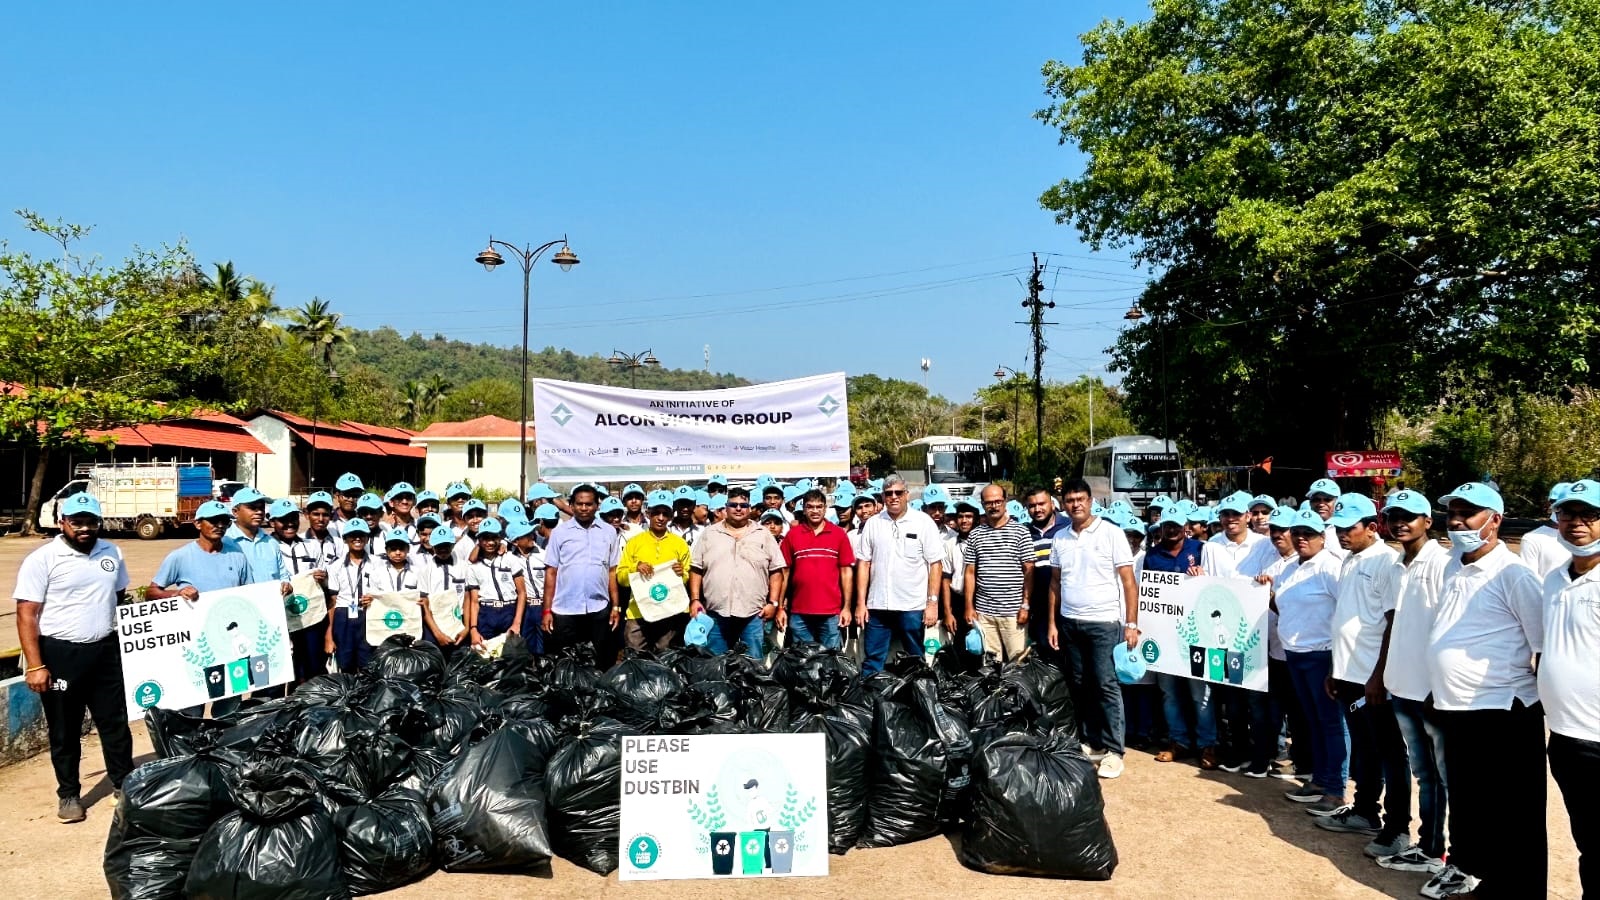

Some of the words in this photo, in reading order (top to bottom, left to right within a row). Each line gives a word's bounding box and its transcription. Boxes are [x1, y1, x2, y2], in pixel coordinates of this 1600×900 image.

[649, 400, 664, 408] AN
[666, 400, 719, 408] INITIATIVE
[721, 399, 735, 408] OF
[595, 413, 656, 427] ALCON
[731, 411, 793, 425] GROUP
[1141, 571, 1180, 586] PLEASE
[1140, 586, 1161, 599] USE
[119, 599, 179, 620] PLEASE
[1139, 600, 1184, 617] DUSTBIN
[121, 620, 153, 637] USE
[123, 630, 192, 654] DUSTBIN
[625, 737, 690, 753] PLEASE
[625, 759, 659, 774] USE
[623, 779, 700, 795] DUSTBIN
